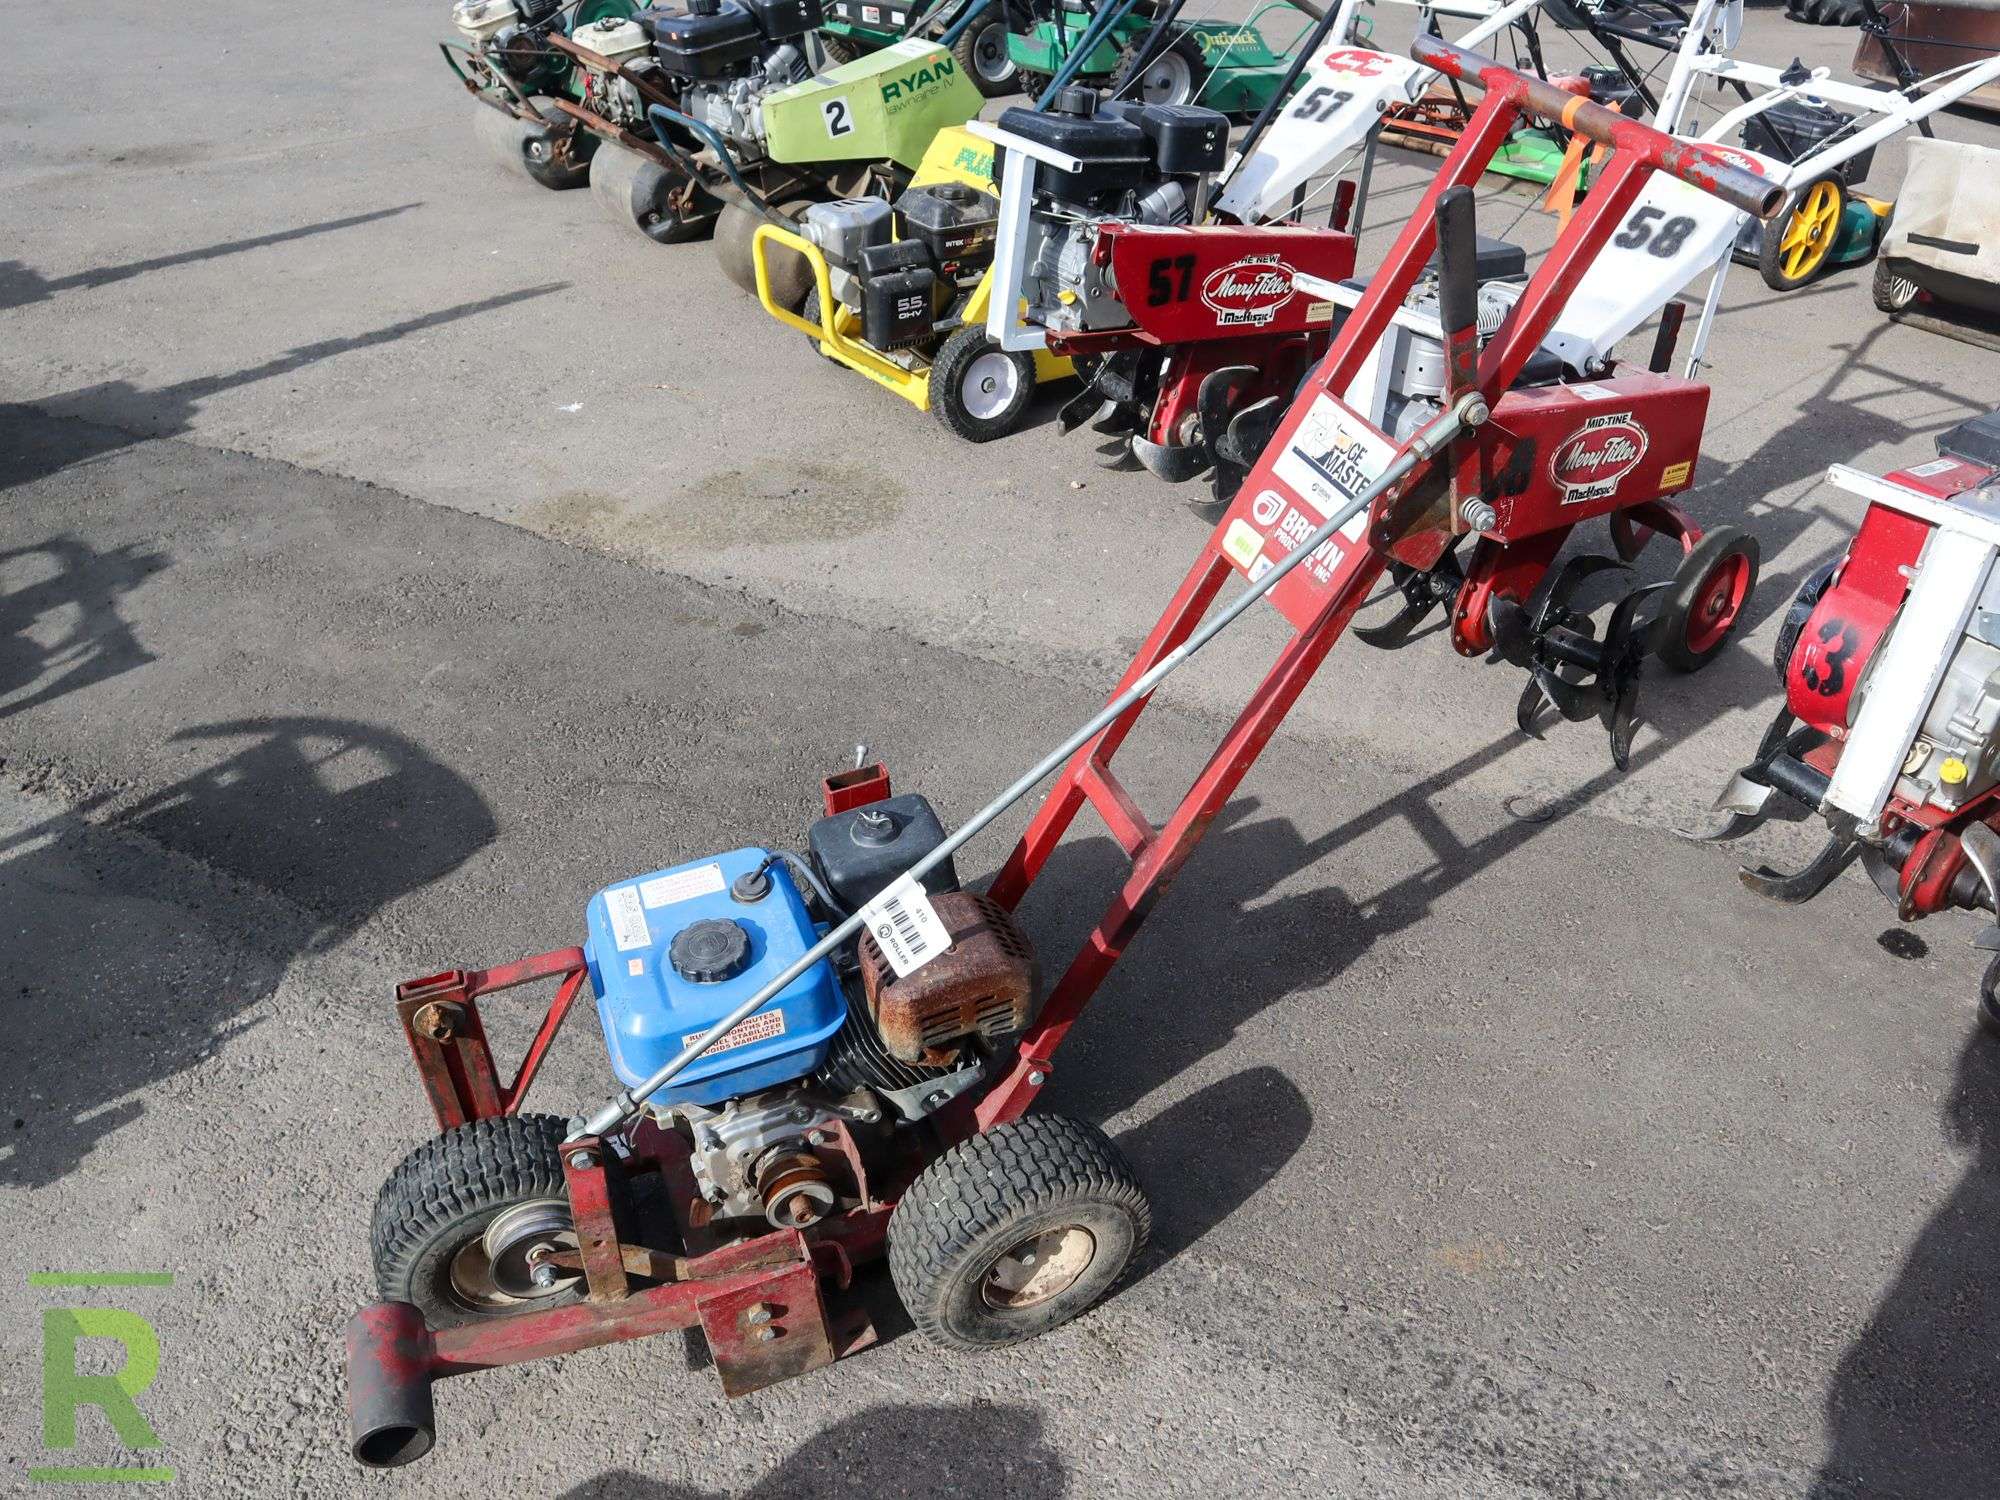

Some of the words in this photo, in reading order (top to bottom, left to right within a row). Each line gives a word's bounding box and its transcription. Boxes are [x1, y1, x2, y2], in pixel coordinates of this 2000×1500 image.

[881, 57, 955, 103] RYAN
[826, 101, 851, 136] 2
[1294, 86, 1354, 123] 57
[1614, 205, 1697, 258] 58
[1256, 255, 1276, 263] NEW
[1148, 256, 1196, 307] 57
[1208, 273, 1258, 302] Merry
[1254, 272, 1291, 296] Tiller
[898, 309, 923, 319] OHV
[1560, 441, 1606, 474] Merry
[1602, 435, 1637, 466] Tiller
[1325, 450, 1371, 495] MASTE
[1802, 618, 1858, 697] 3
[889, 937, 909, 965] ROLLER
[732, 1023, 782, 1041] STABILIZER
[763, 1017, 781, 1026] AND
[705, 1042, 731, 1055] VOIDS
[733, 1029, 781, 1047] WARRANTY
